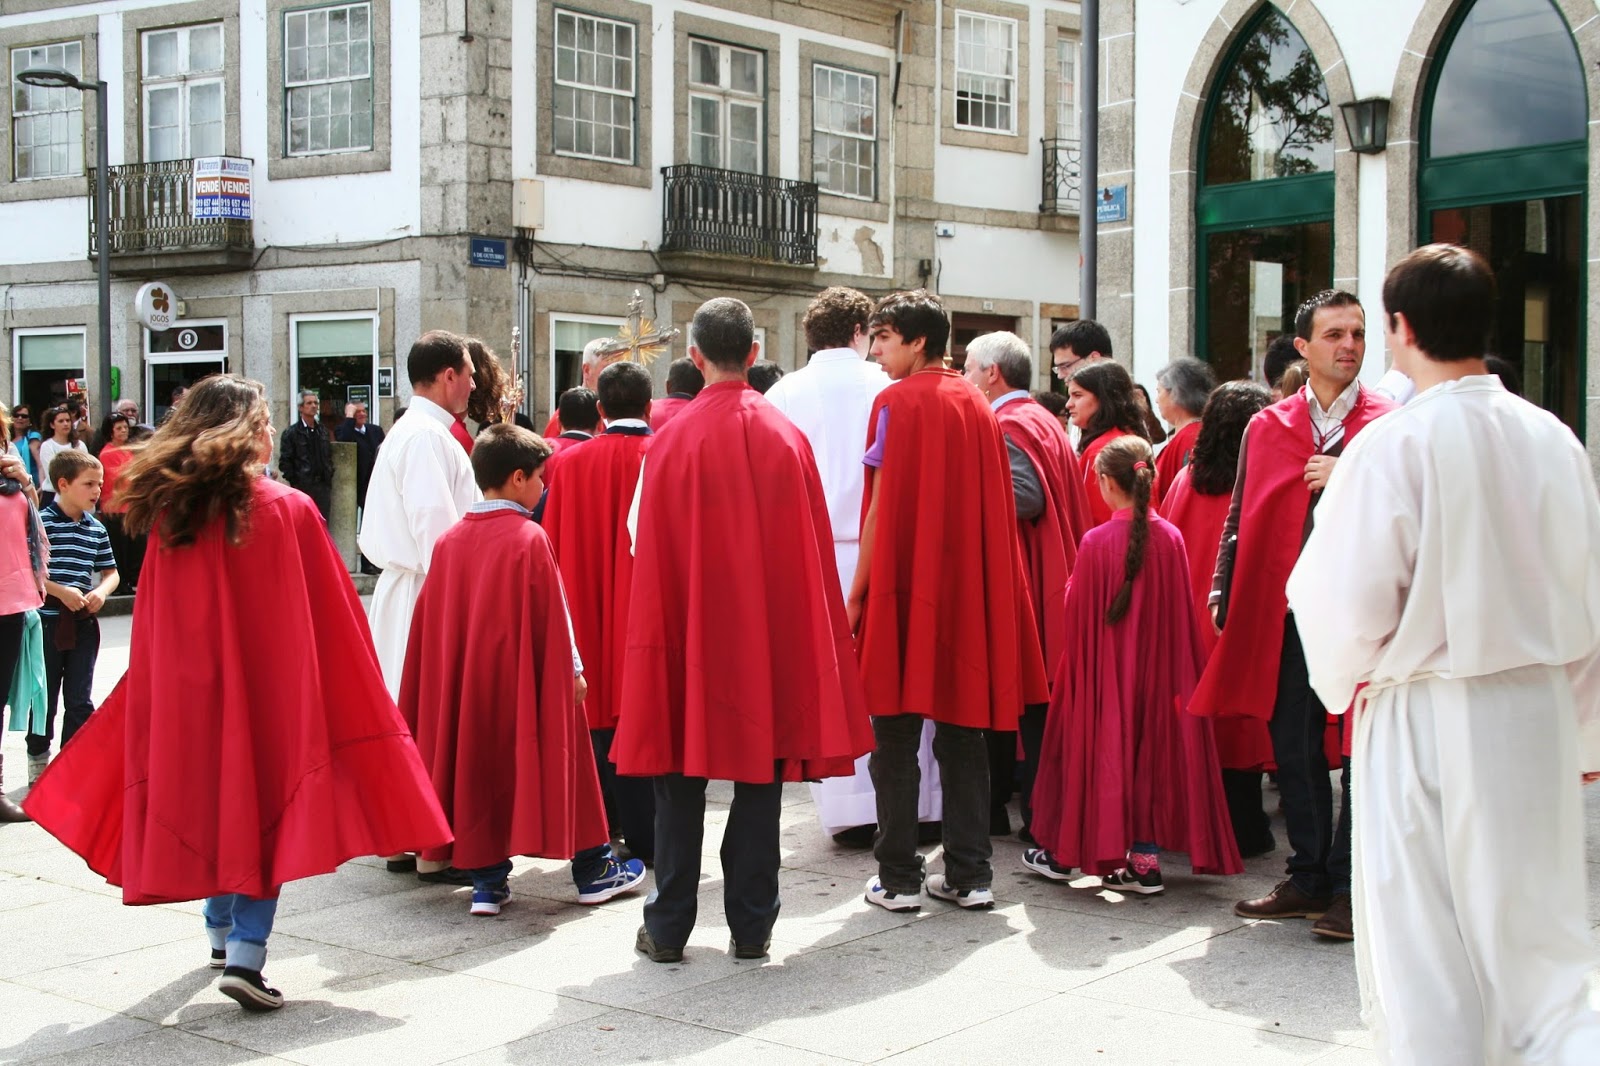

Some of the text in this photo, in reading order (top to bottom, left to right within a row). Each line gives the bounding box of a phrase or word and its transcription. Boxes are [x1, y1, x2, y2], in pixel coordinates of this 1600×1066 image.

[196, 180, 219, 193] VENDE
[221, 180, 250, 195] VENDE
[221, 198, 250, 208] 919 657 444
[221, 207, 250, 217] 255 437 285
[150, 314, 169, 323] JOGOS
[184, 333, 192, 345] 3
